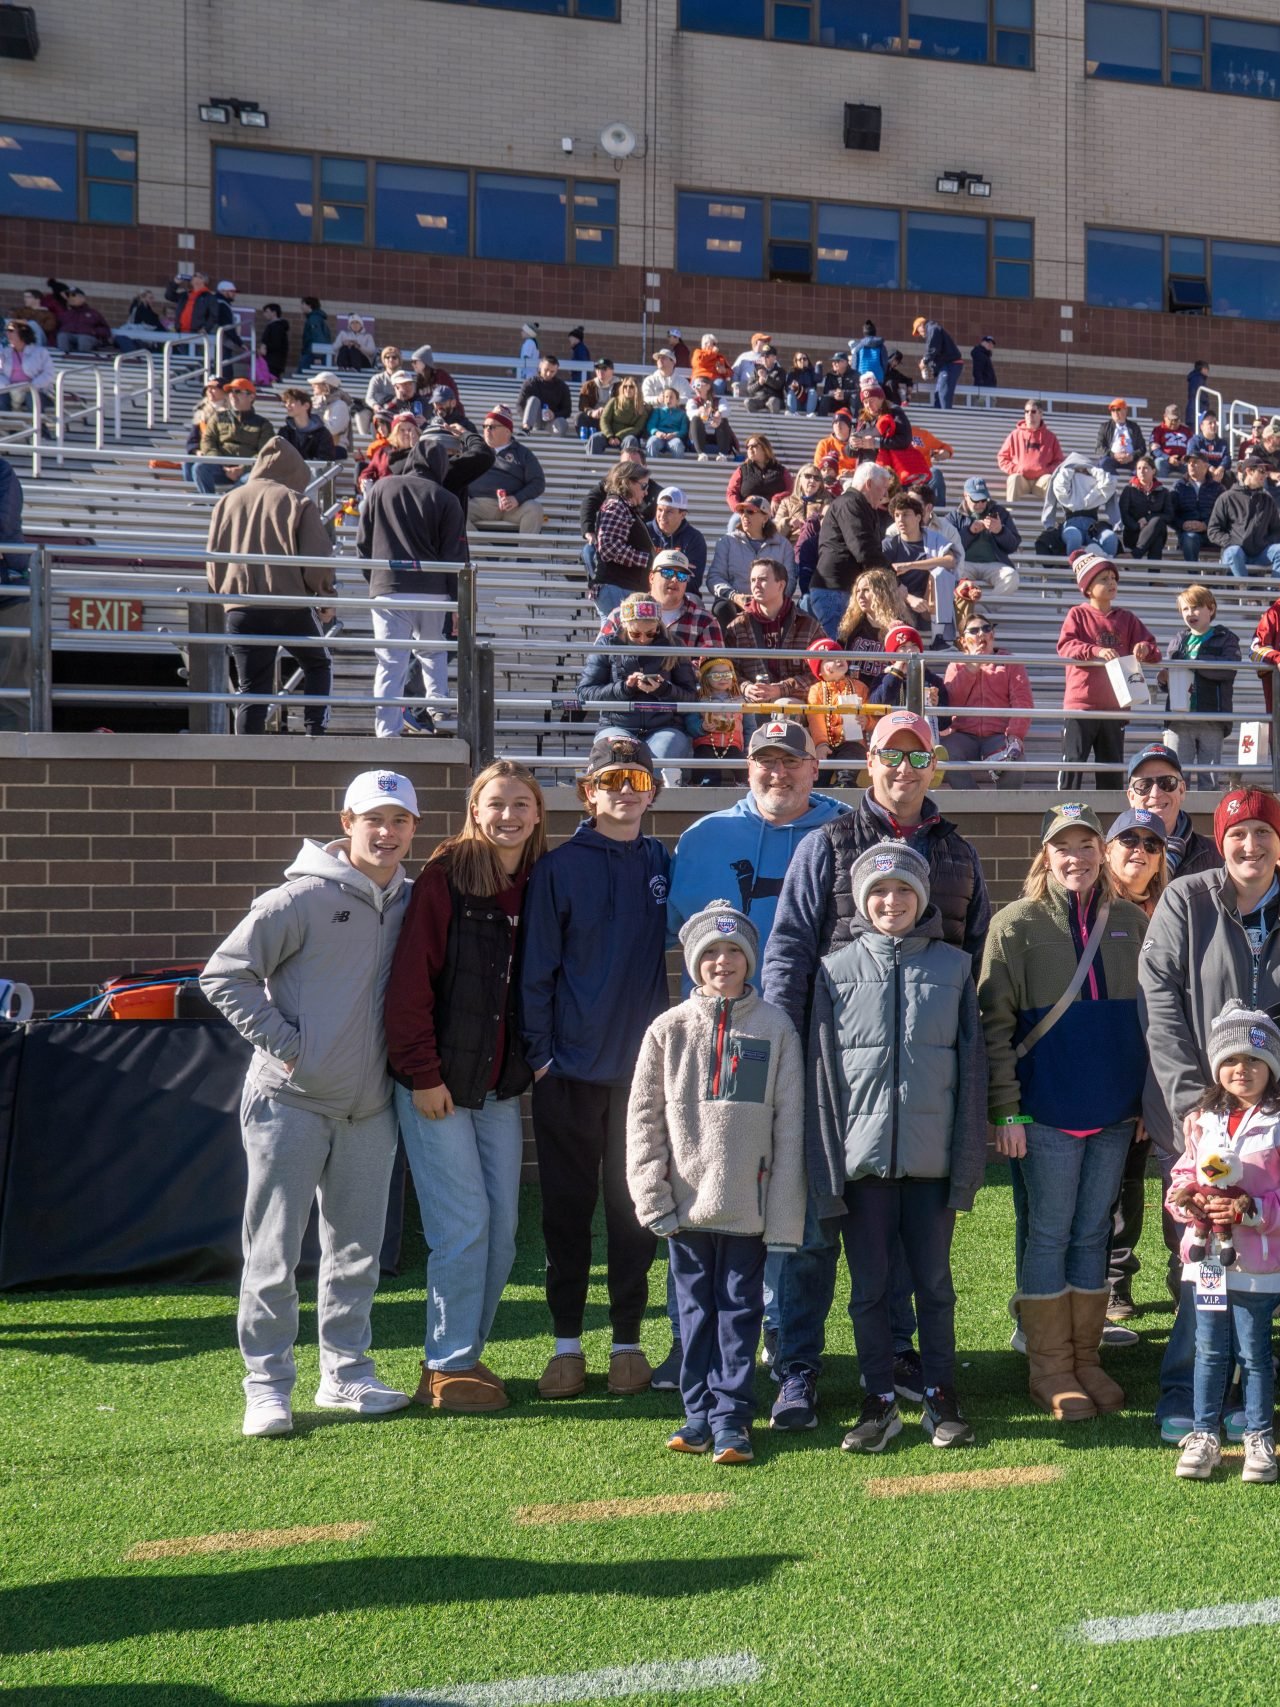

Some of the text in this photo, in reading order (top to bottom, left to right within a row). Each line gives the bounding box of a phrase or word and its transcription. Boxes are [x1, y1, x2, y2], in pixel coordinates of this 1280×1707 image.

[1164, 432, 1187, 447] 22
[82, 600, 132, 630] EXIT
[1199, 1262, 1223, 1275] Team
[1202, 1295, 1221, 1305] V.I.P.
